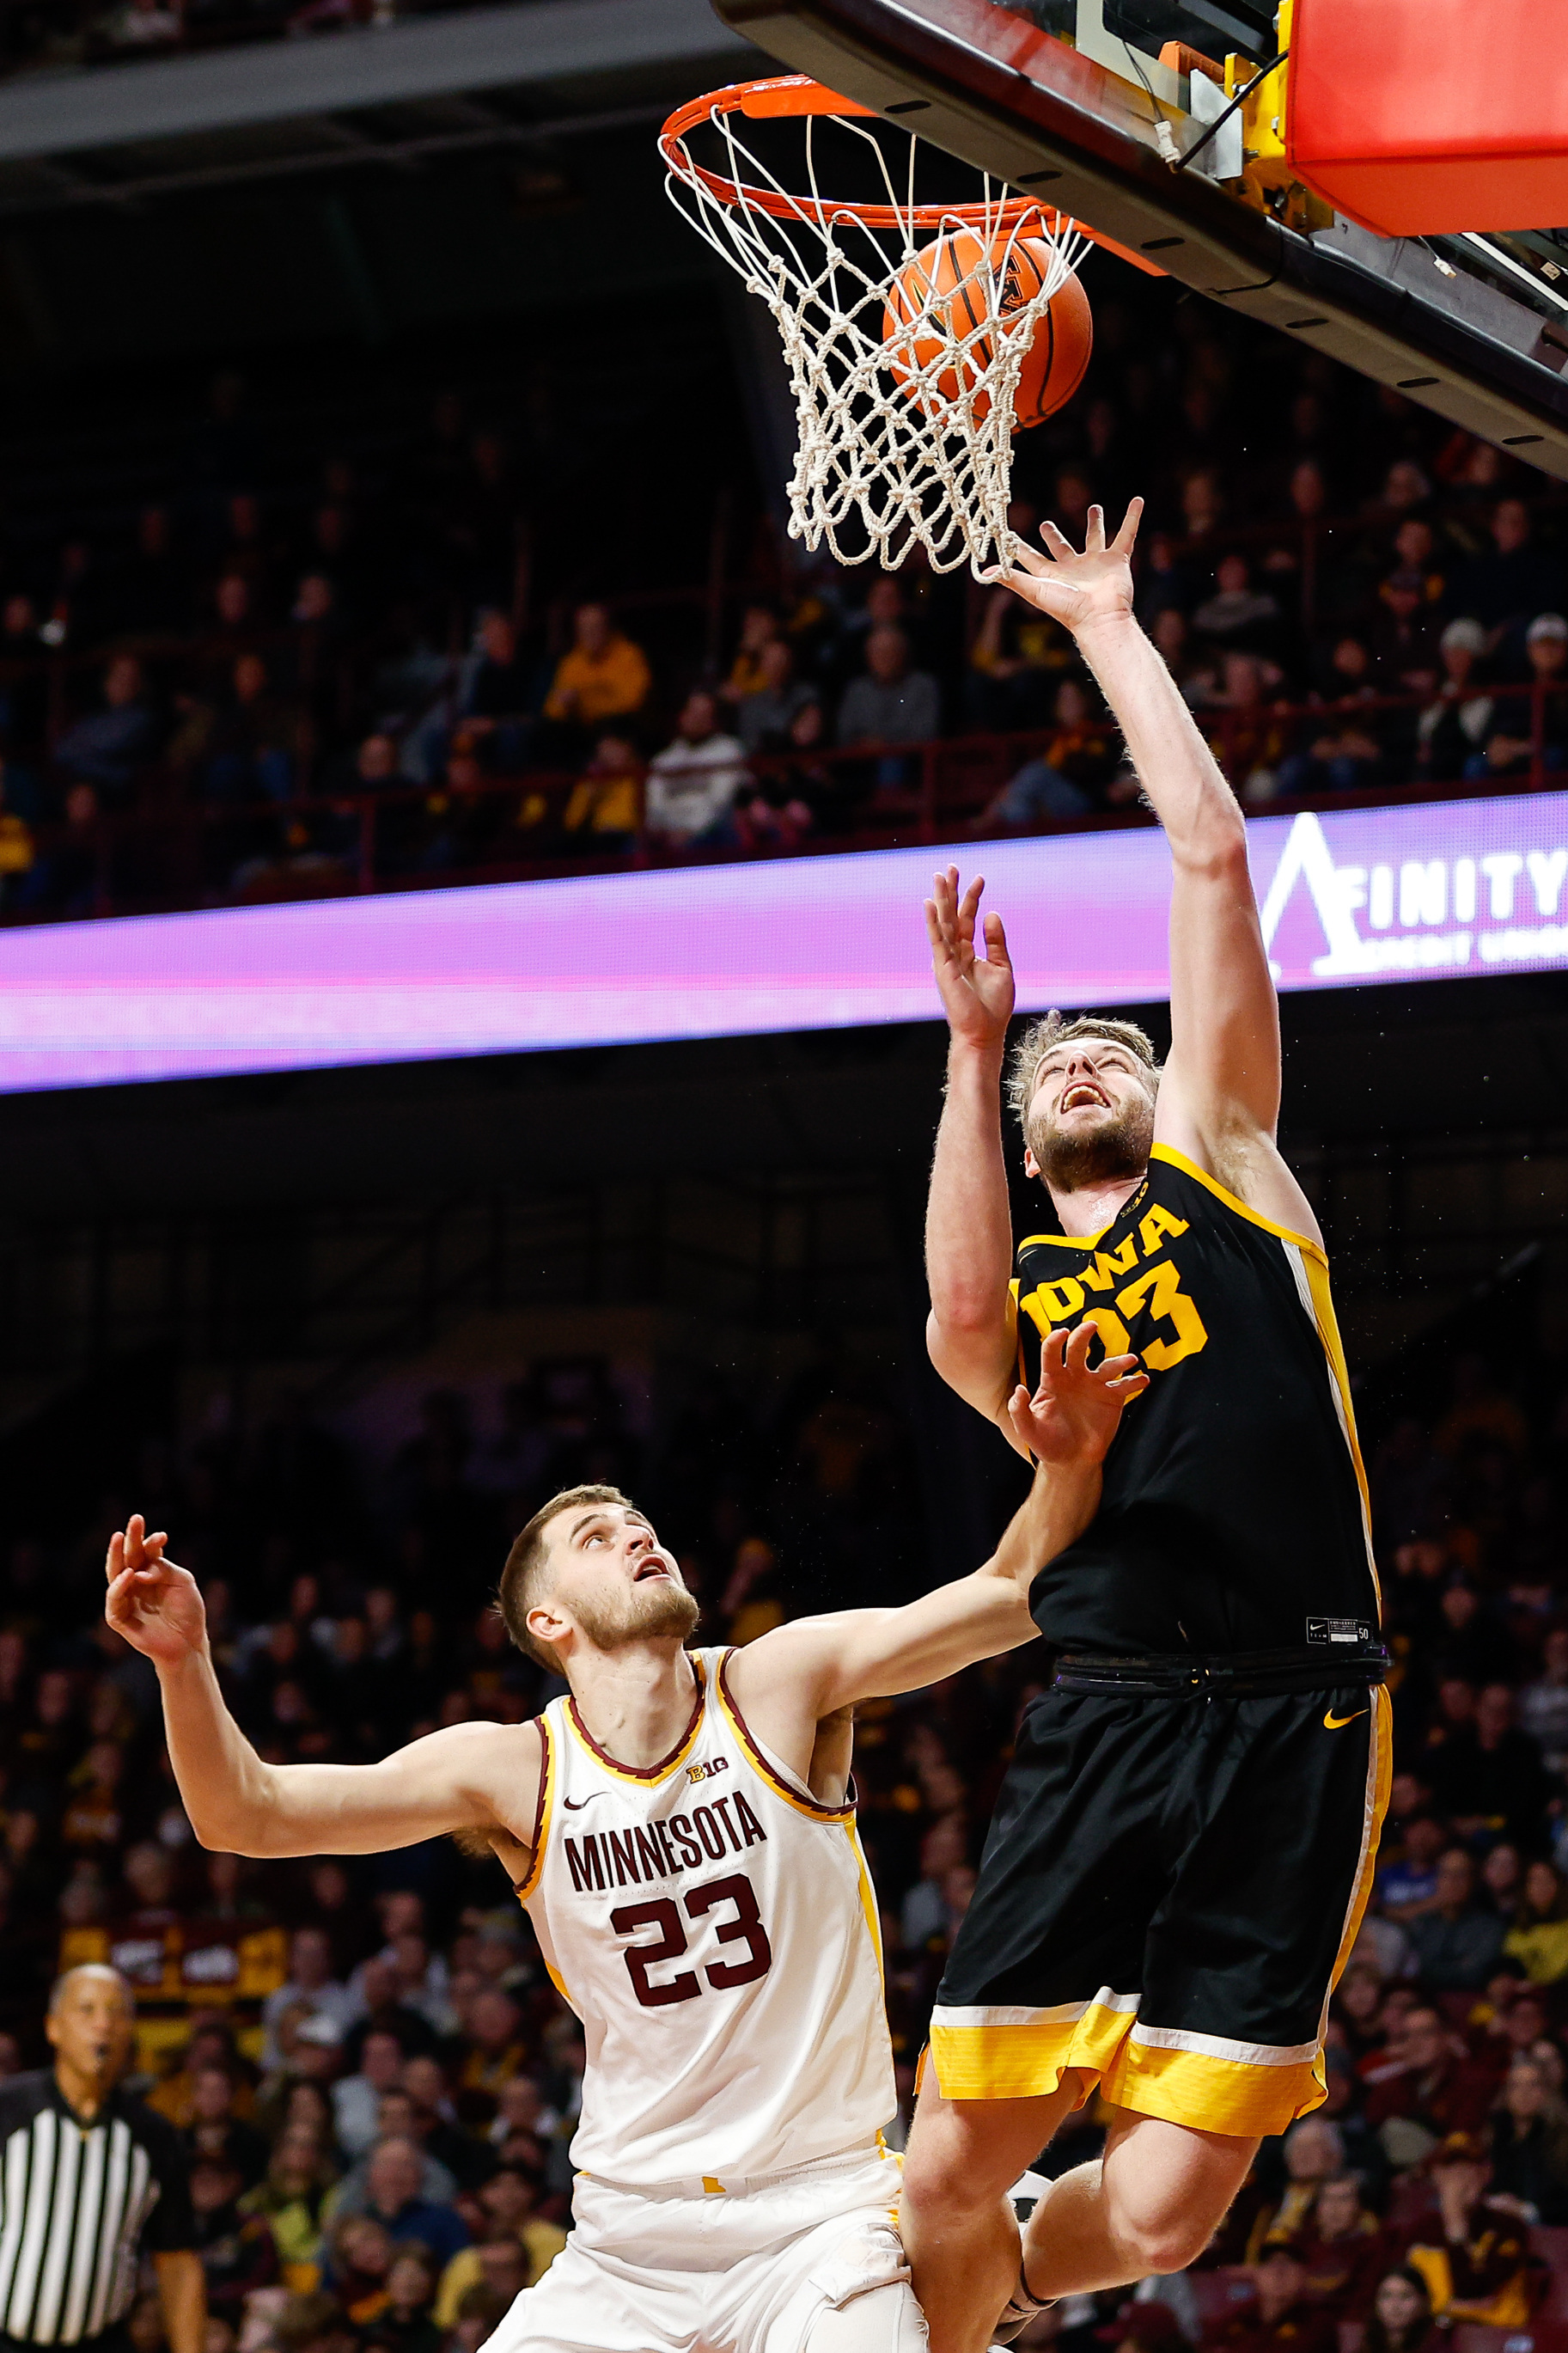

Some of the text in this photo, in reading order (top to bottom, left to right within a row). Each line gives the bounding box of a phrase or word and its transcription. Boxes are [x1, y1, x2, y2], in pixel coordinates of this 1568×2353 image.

[1020, 1203, 1190, 1342] IOWA
[1358, 1628, 1369, 1640] 50
[564, 1790, 767, 1892] MINNESOTA
[610, 1873, 772, 2007] 23
